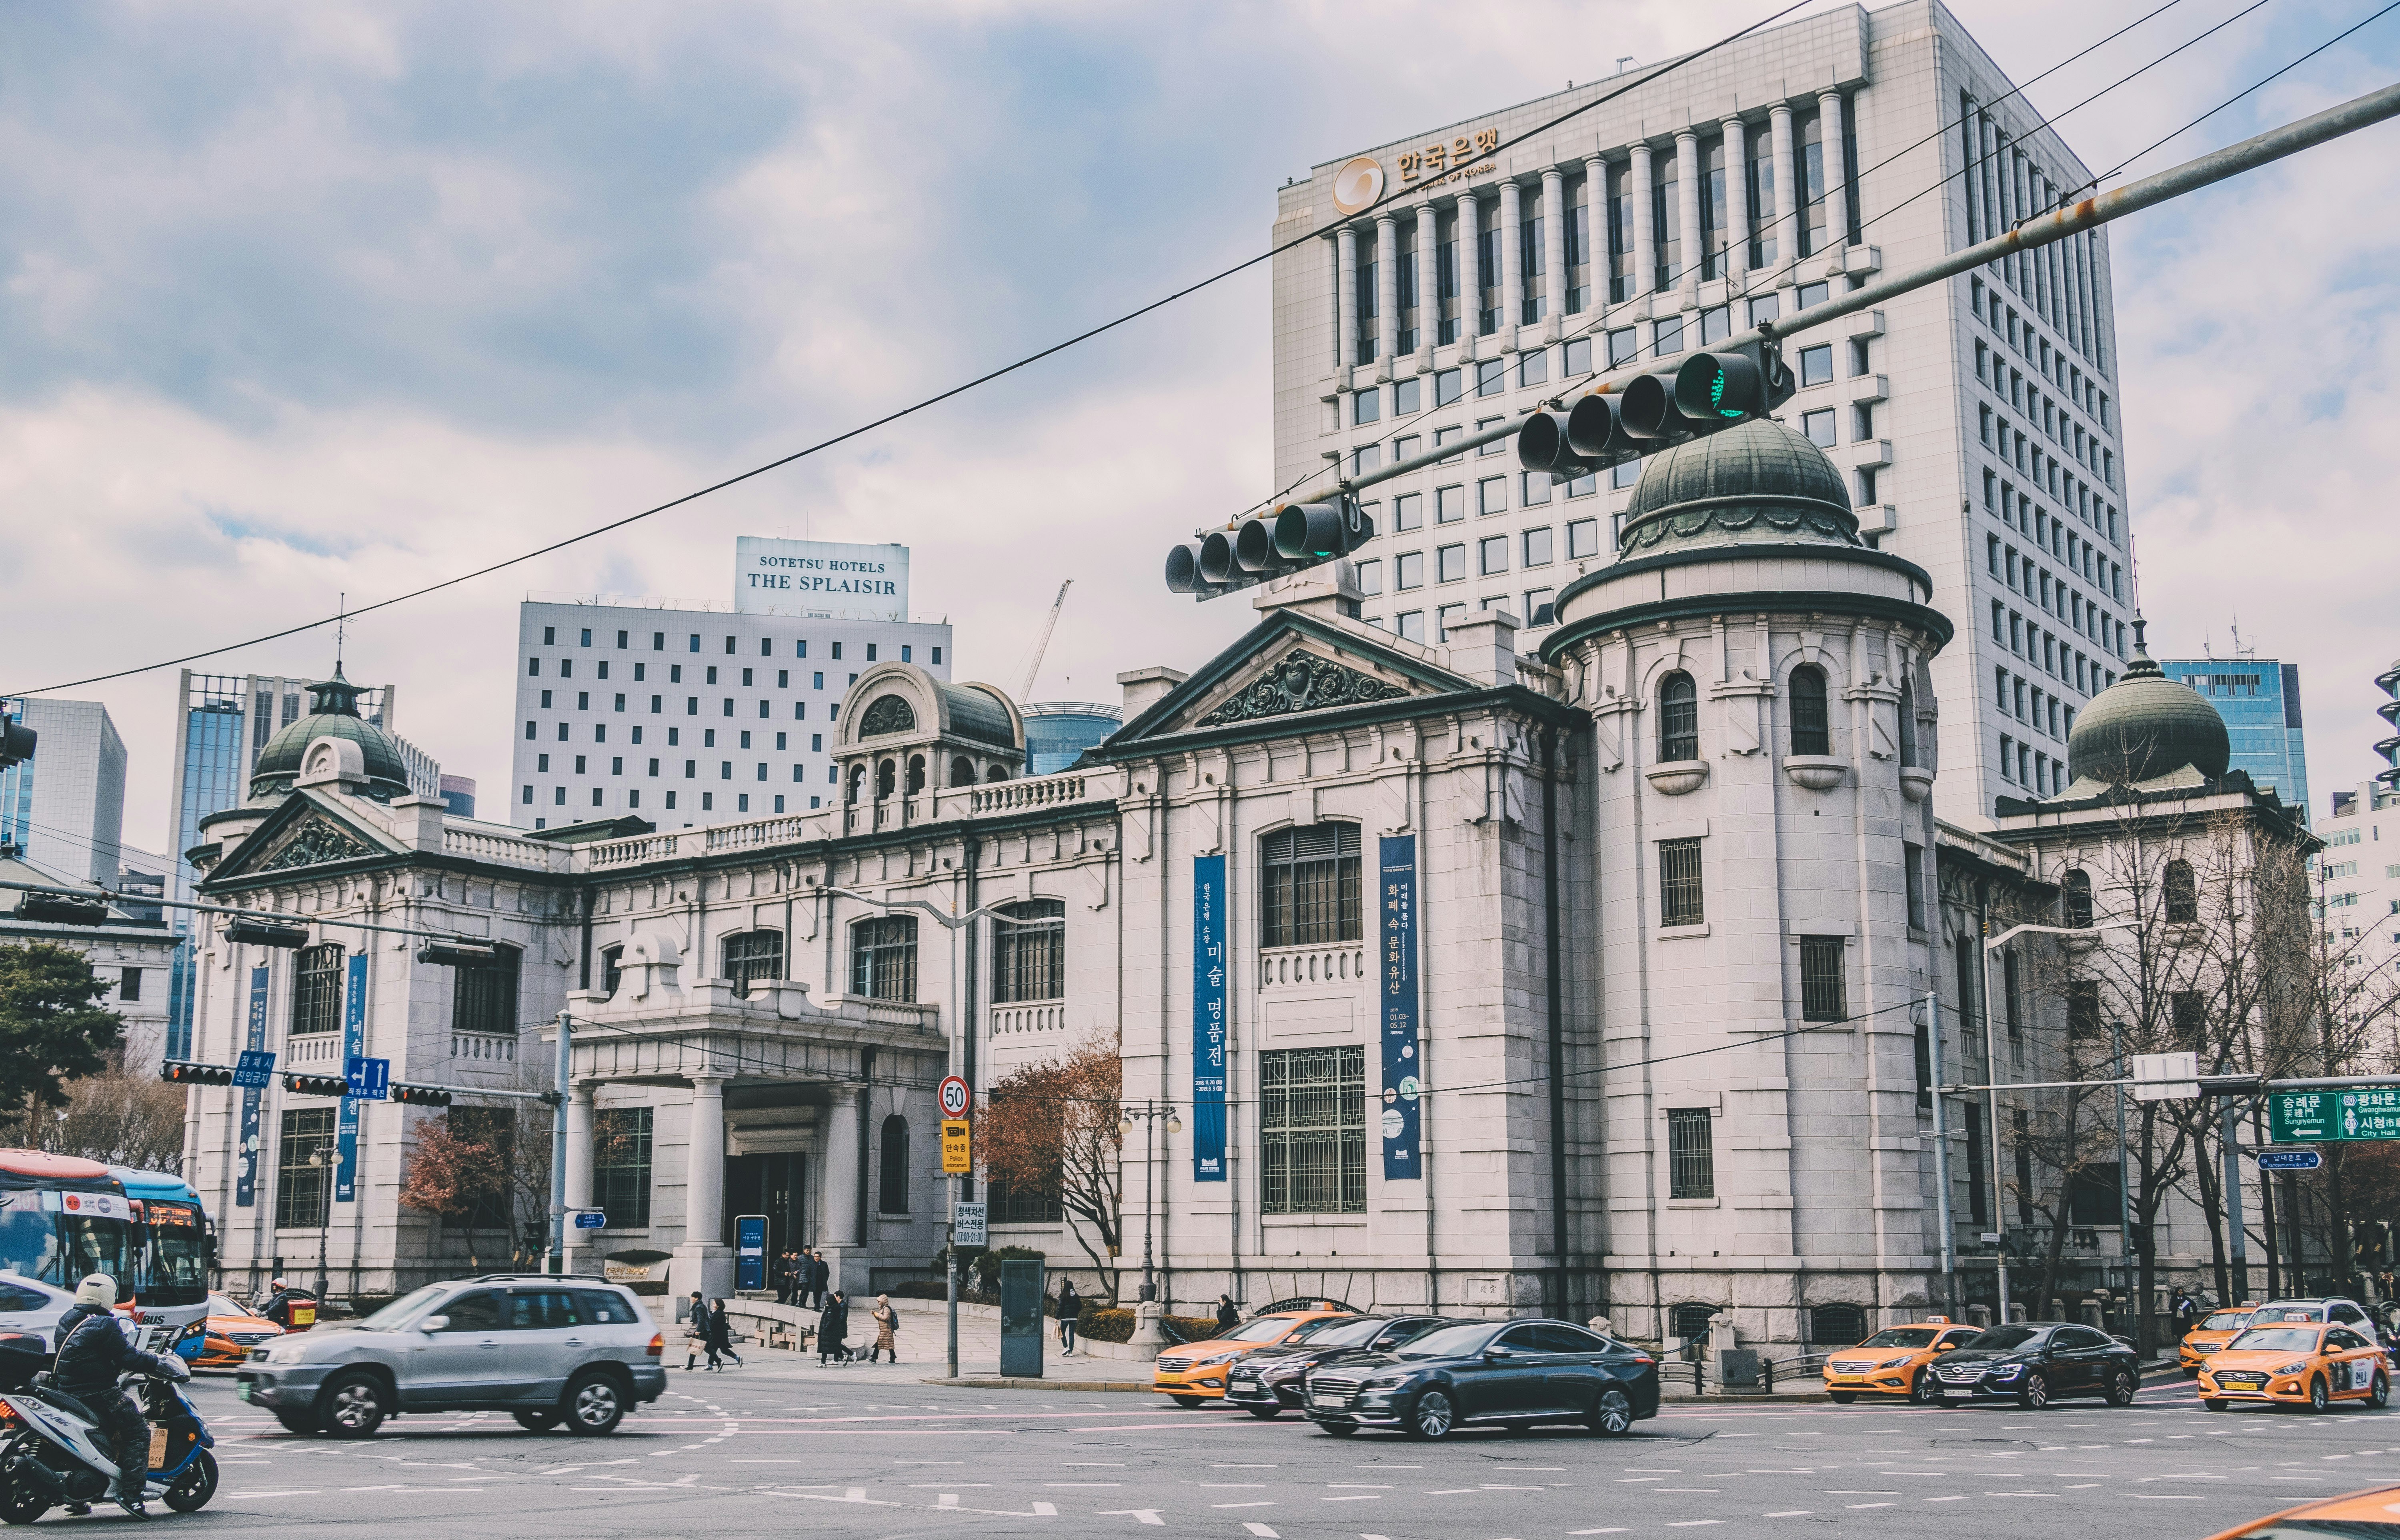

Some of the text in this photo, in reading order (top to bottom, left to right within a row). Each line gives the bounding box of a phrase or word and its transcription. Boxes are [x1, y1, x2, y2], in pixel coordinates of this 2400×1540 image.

[1397, 127, 1497, 181] 한국은행
[1449, 172, 1461, 181] OF
[1464, 162, 1496, 177] KOREA
[760, 556, 885, 573] SOTETSU HOTELS
[748, 573, 896, 595] THE SPLAISIR
[1203, 883, 1211, 944] 한국은행 소장
[1401, 912, 1408, 929] 품다
[1388, 884, 1400, 994] 화폐 속 문화유산
[1207, 942, 1223, 1066] 미술 명품전
[351, 1020, 362, 1055] 미술
[237, 1070, 269, 1084] 진입금지
[946, 1087, 963, 1107] 50
[2282, 1096, 2321, 1108] 숭례문
[2358, 1093, 2400, 1106] 광화문
[946, 1144, 966, 1152] 단속중
[958, 1206, 984, 1217] 청색차선
[957, 1219, 984, 1230] 버스전용
[957, 1232, 983, 1242] 07:00-21:00
